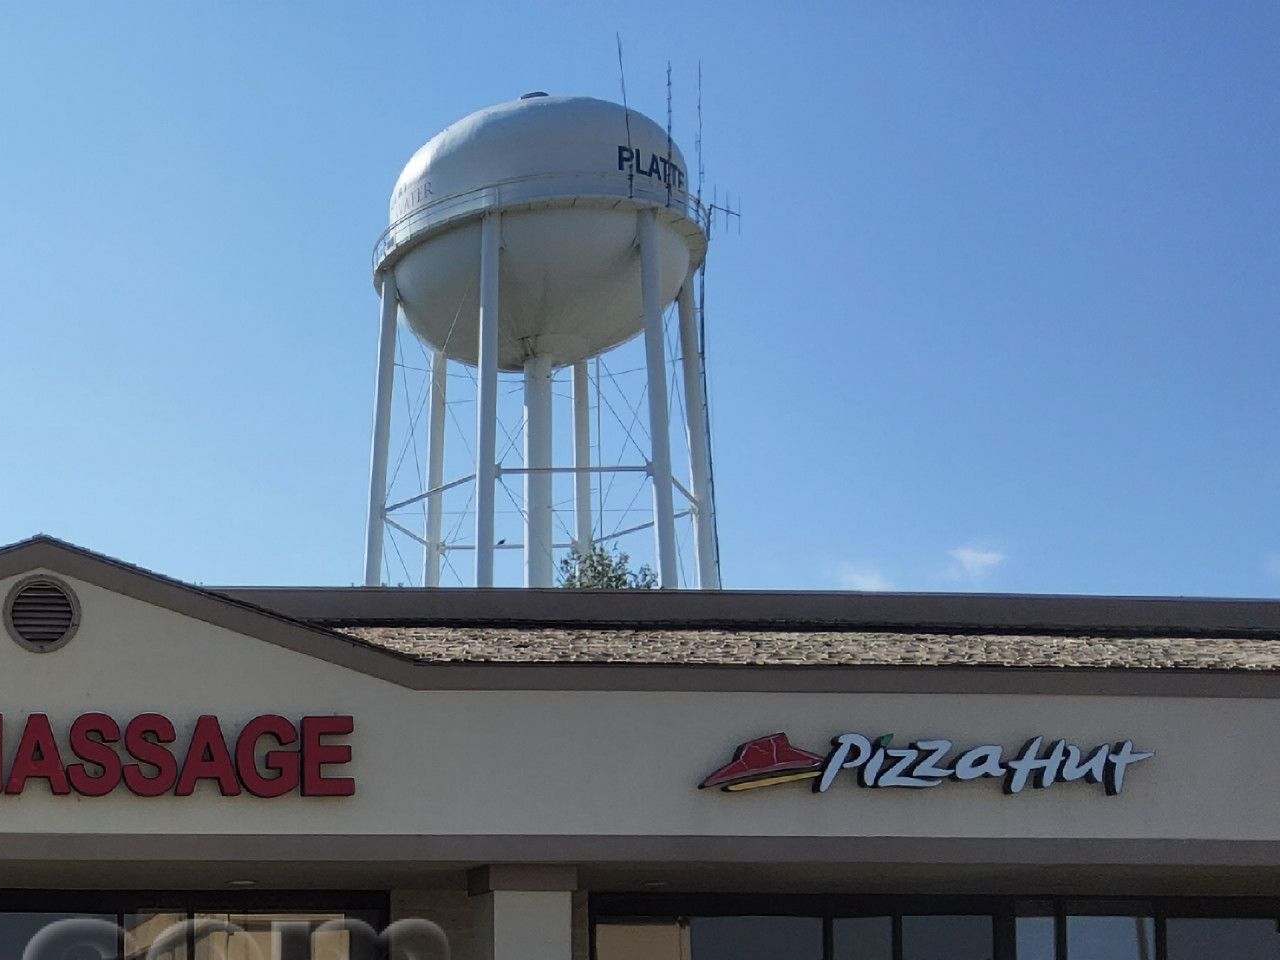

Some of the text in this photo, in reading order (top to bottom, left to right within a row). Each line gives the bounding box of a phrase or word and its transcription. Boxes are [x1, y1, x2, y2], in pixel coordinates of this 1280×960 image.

[618, 145, 685, 188] PLATTE
[814, 733, 1156, 795] Pizza Hut
